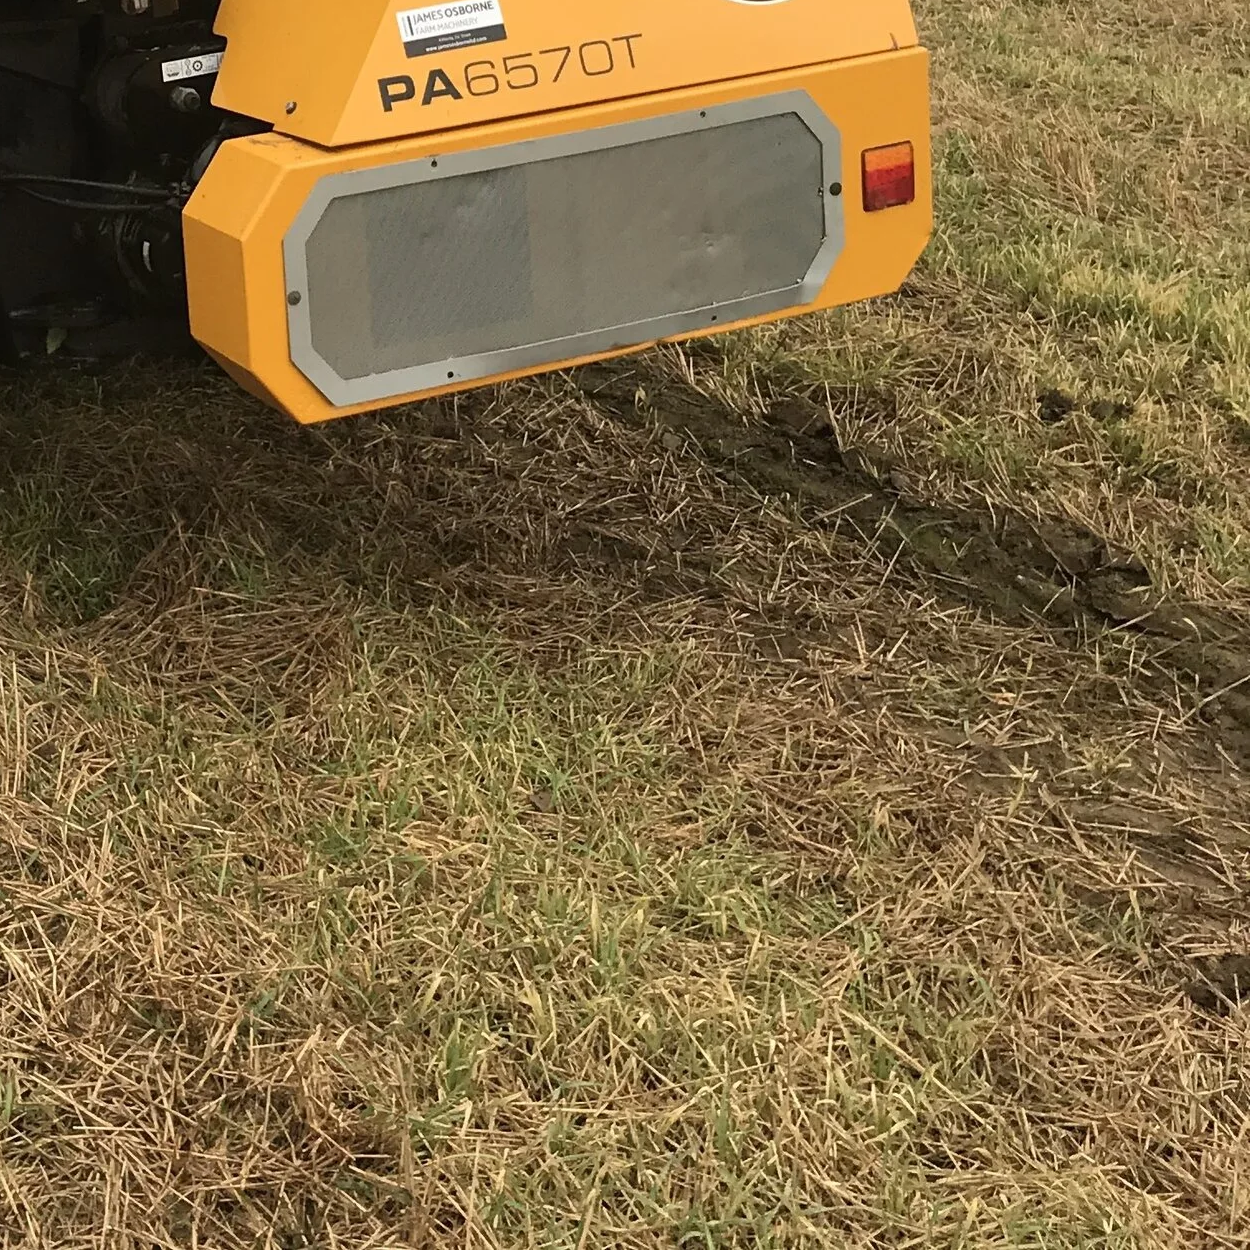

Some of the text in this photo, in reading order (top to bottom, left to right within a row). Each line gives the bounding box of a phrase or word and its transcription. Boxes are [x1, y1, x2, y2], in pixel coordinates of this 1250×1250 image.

[413, 0, 494, 25] JAMES OSBORNE
[415, 16, 478, 35] FARM MACHINERY
[377, 33, 643, 113] PA6570T
